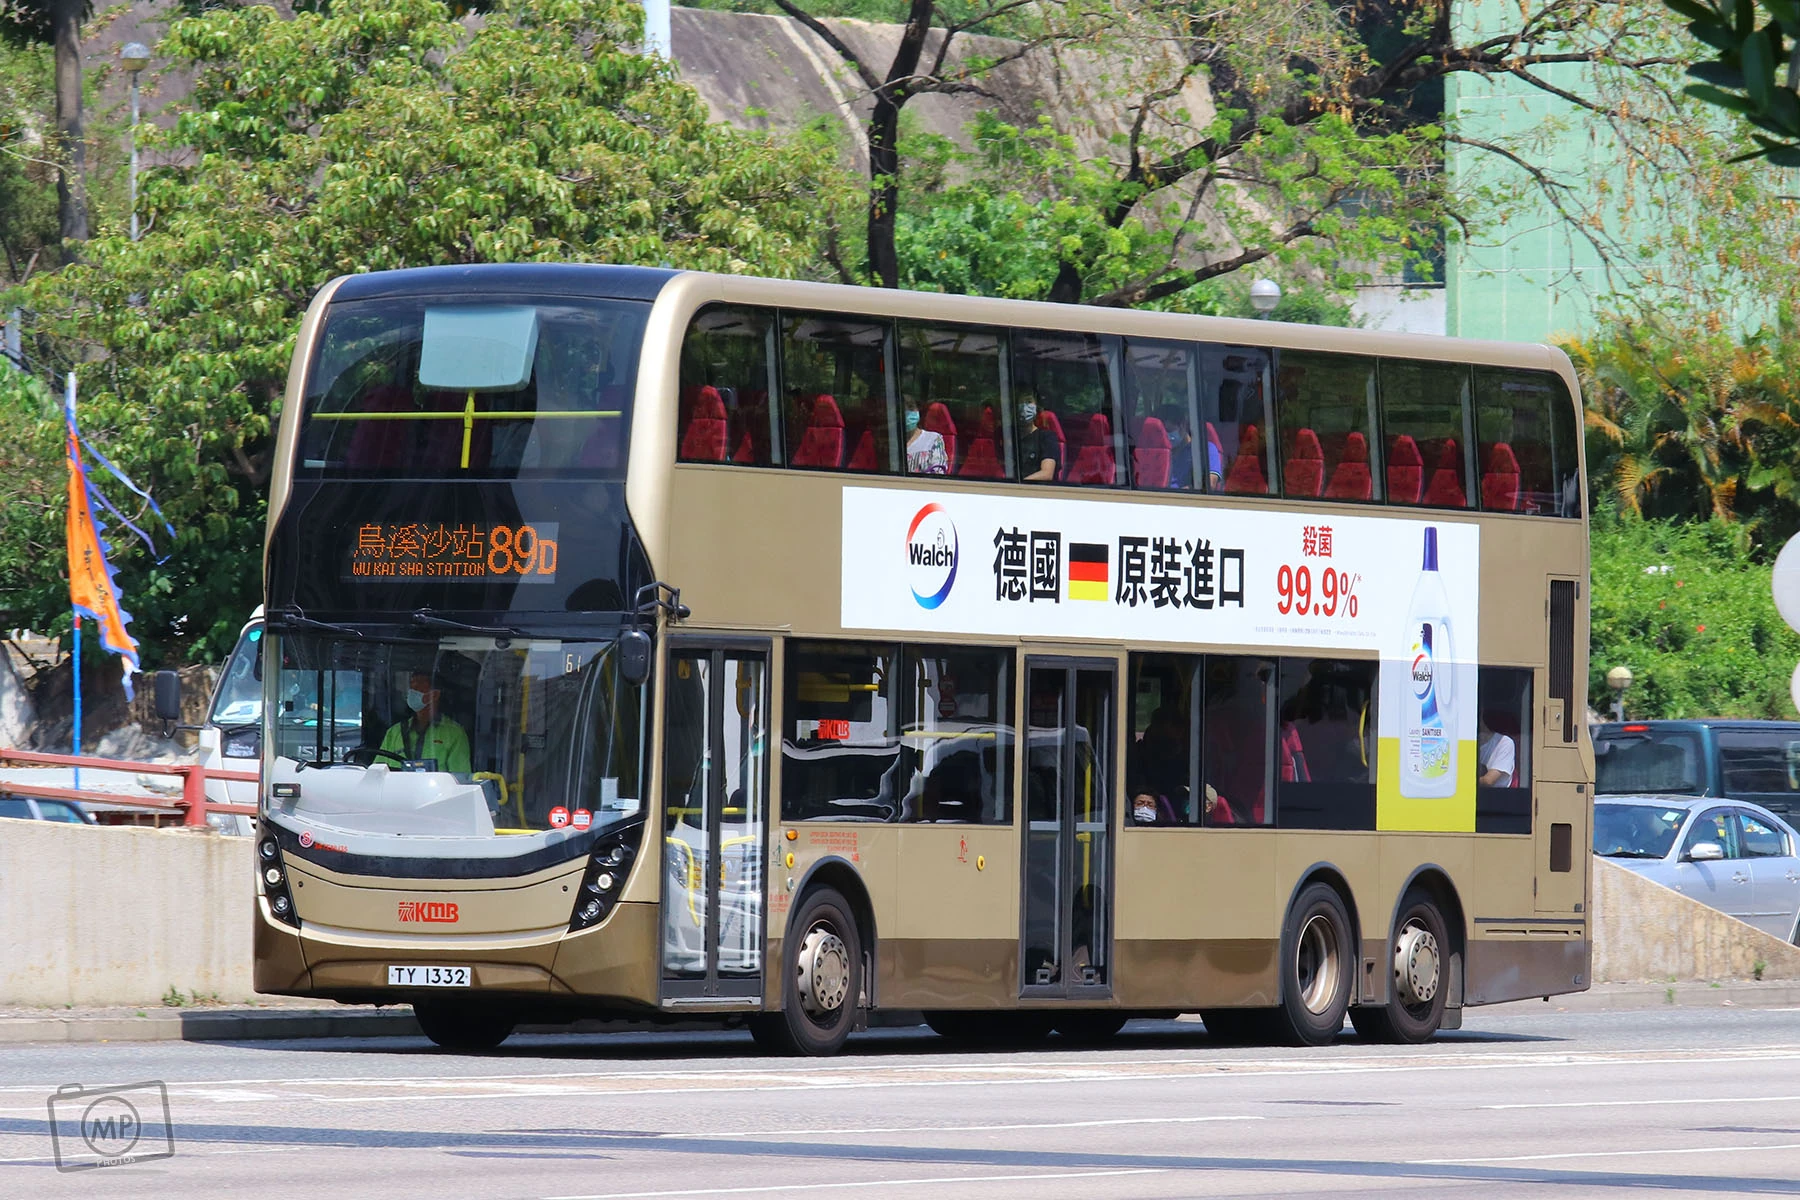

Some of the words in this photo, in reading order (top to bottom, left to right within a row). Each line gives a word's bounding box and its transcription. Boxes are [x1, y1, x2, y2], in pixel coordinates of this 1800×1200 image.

[353, 523, 486, 558] 烏溪沙站
[487, 525, 558, 575] 89D
[909, 542, 954, 567] Walch
[1302, 525, 1333, 558] 殺菌
[352, 562, 370, 576] WU
[373, 562, 396, 576] KAI
[399, 562, 424, 576] SHA
[426, 562, 486, 576] STATION
[1115, 535, 1245, 609] 原裝進口
[415, 902, 459, 923] KMB
[394, 967, 417, 984] TY
[425, 967, 466, 985] 1332
